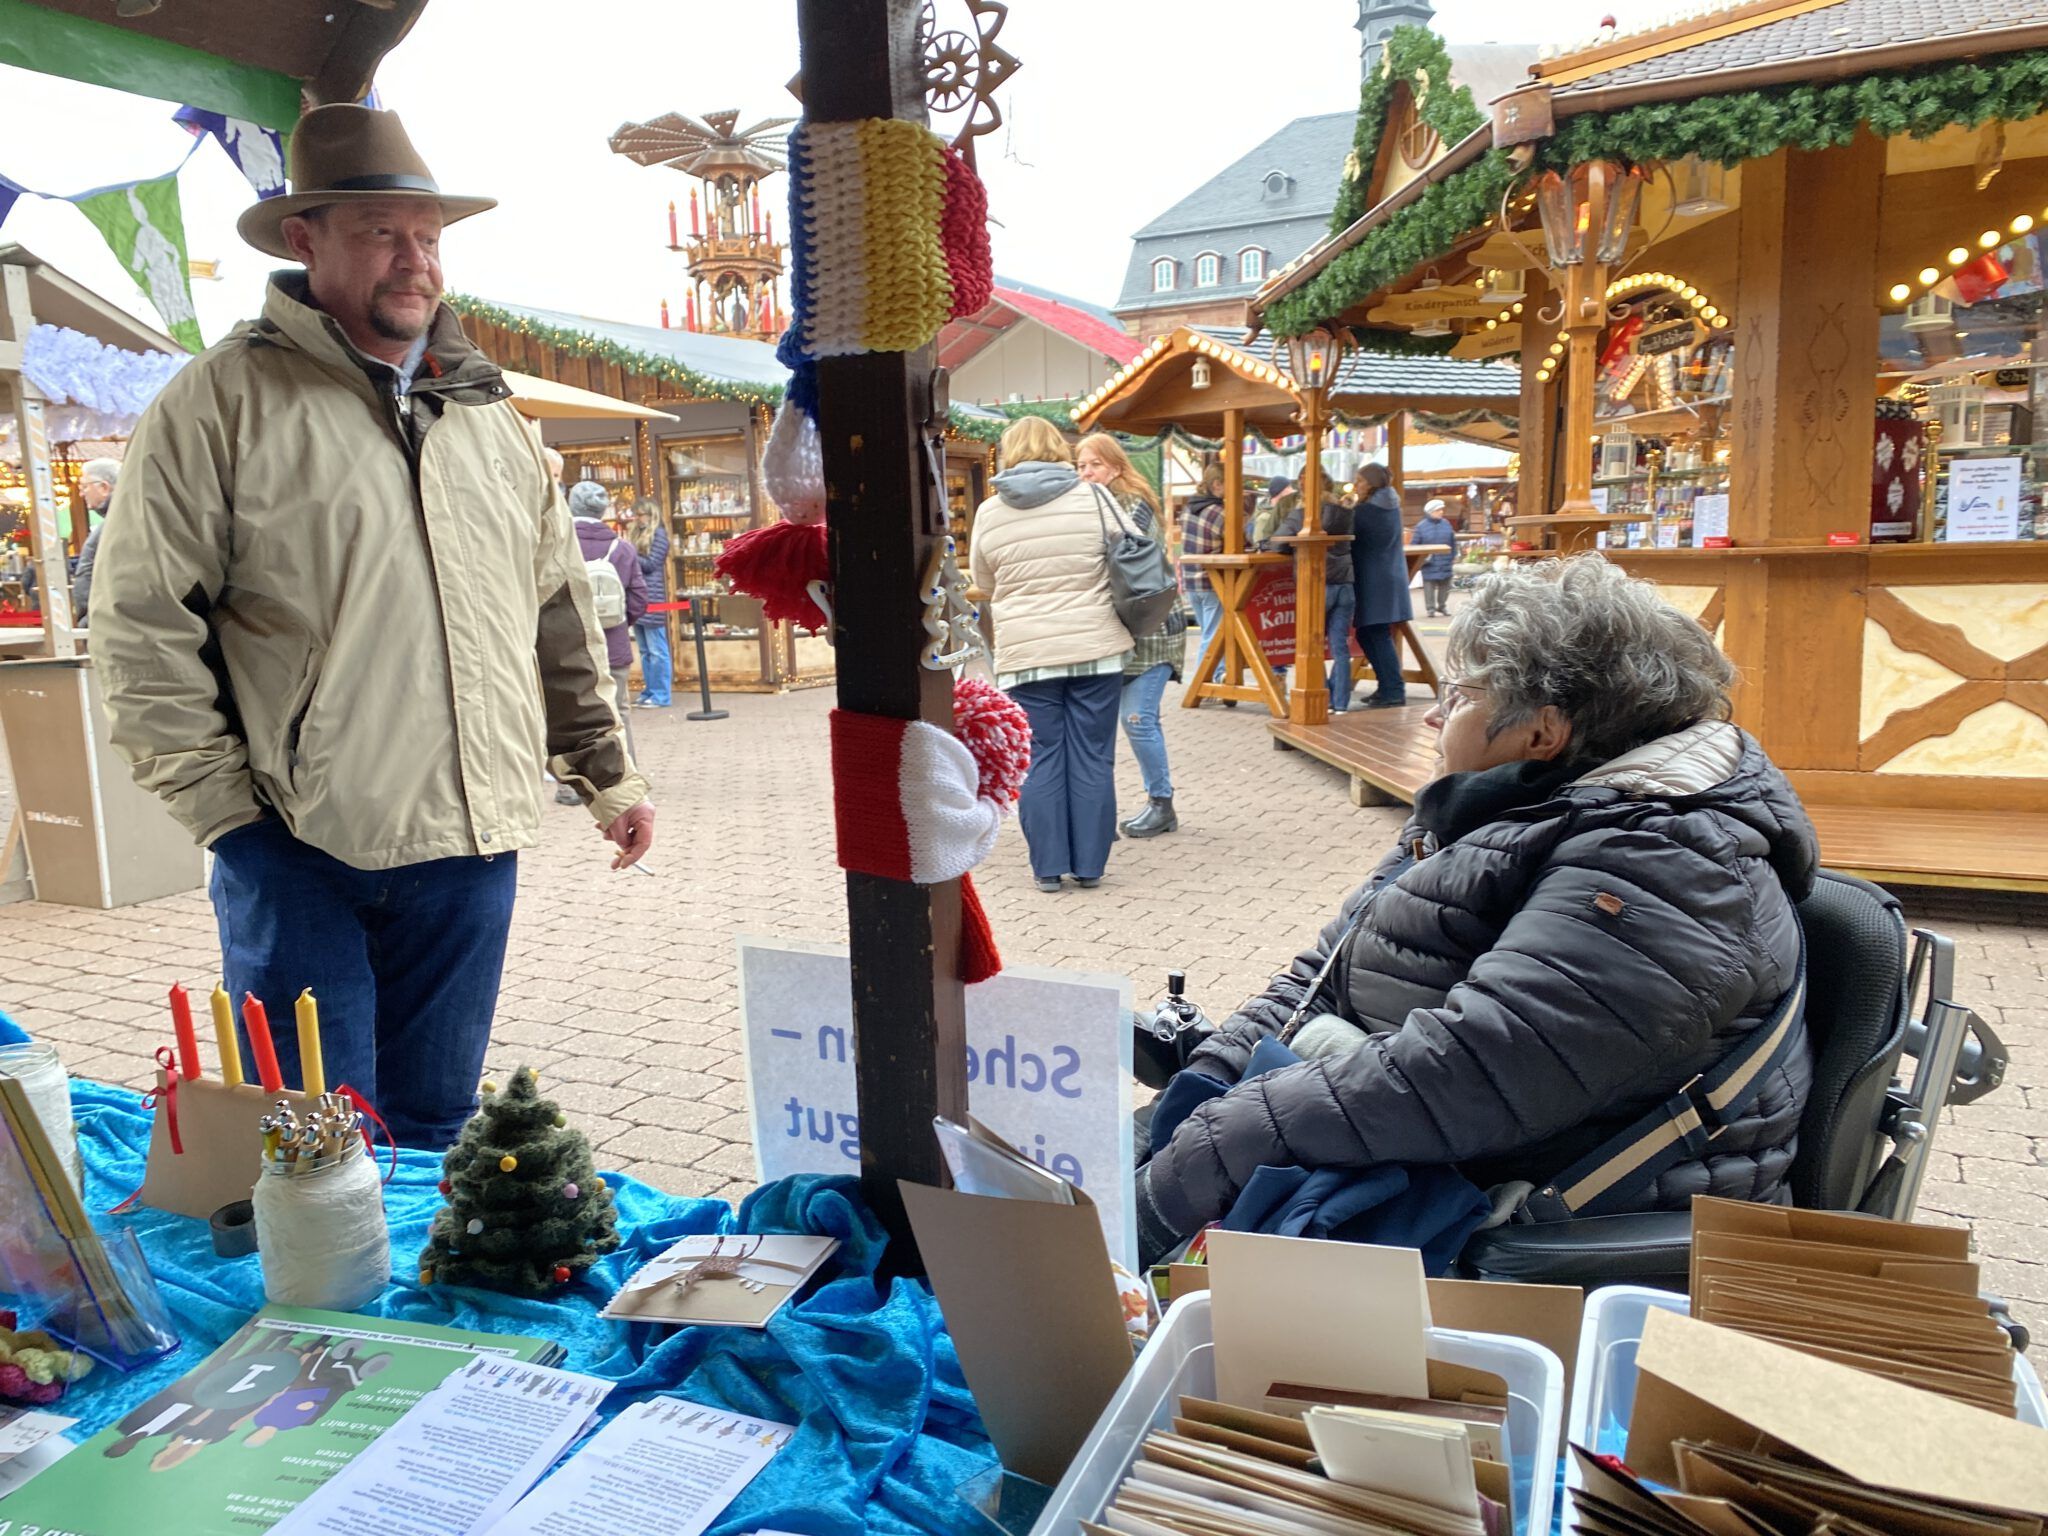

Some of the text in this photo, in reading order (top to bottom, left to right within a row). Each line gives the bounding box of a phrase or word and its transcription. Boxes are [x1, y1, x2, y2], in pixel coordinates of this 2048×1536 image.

[355, 1393, 375, 1402] für
[320, 1418, 349, 1428] mit?
[350, 1422, 369, 1432] ich
[315, 1448, 353, 1460] retten
[224, 1504, 265, 1517] genau
